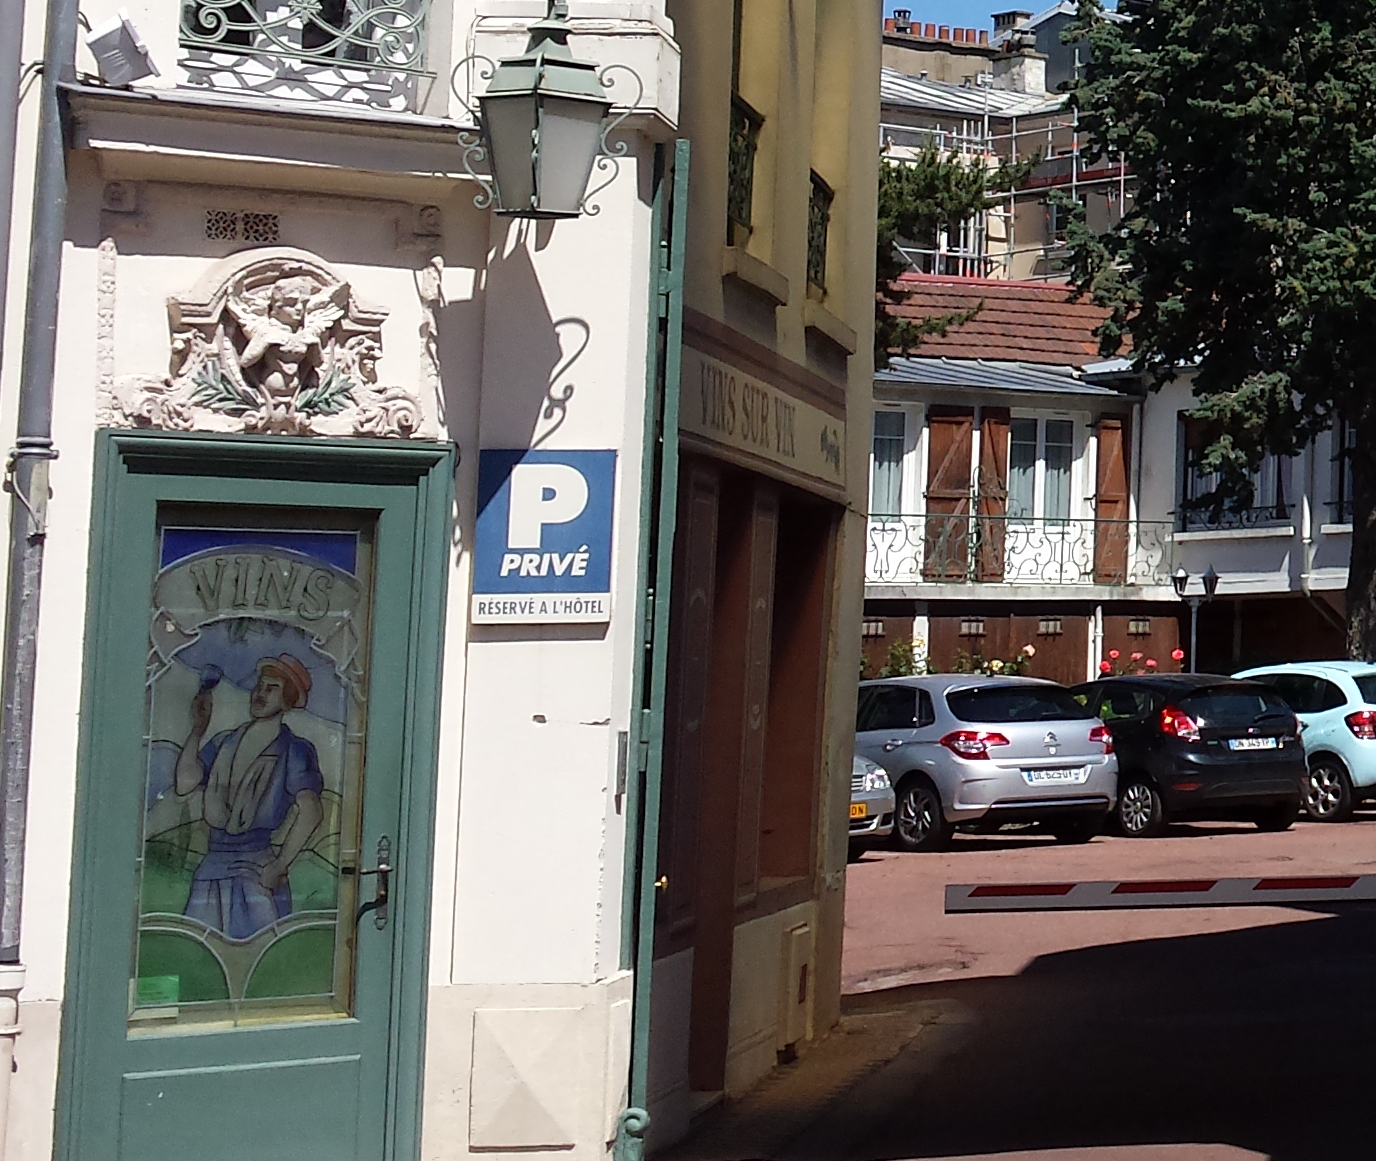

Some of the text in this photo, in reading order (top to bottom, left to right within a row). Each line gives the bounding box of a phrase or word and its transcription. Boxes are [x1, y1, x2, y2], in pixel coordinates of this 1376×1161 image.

[741, 382, 770, 449] SUR
[507, 463, 589, 549] P
[190, 555, 335, 622] VINS
[499, 544, 590, 577] PRIVÉ
[478, 597, 604, 615] RÉSERVÉ A L'HÔTEL
